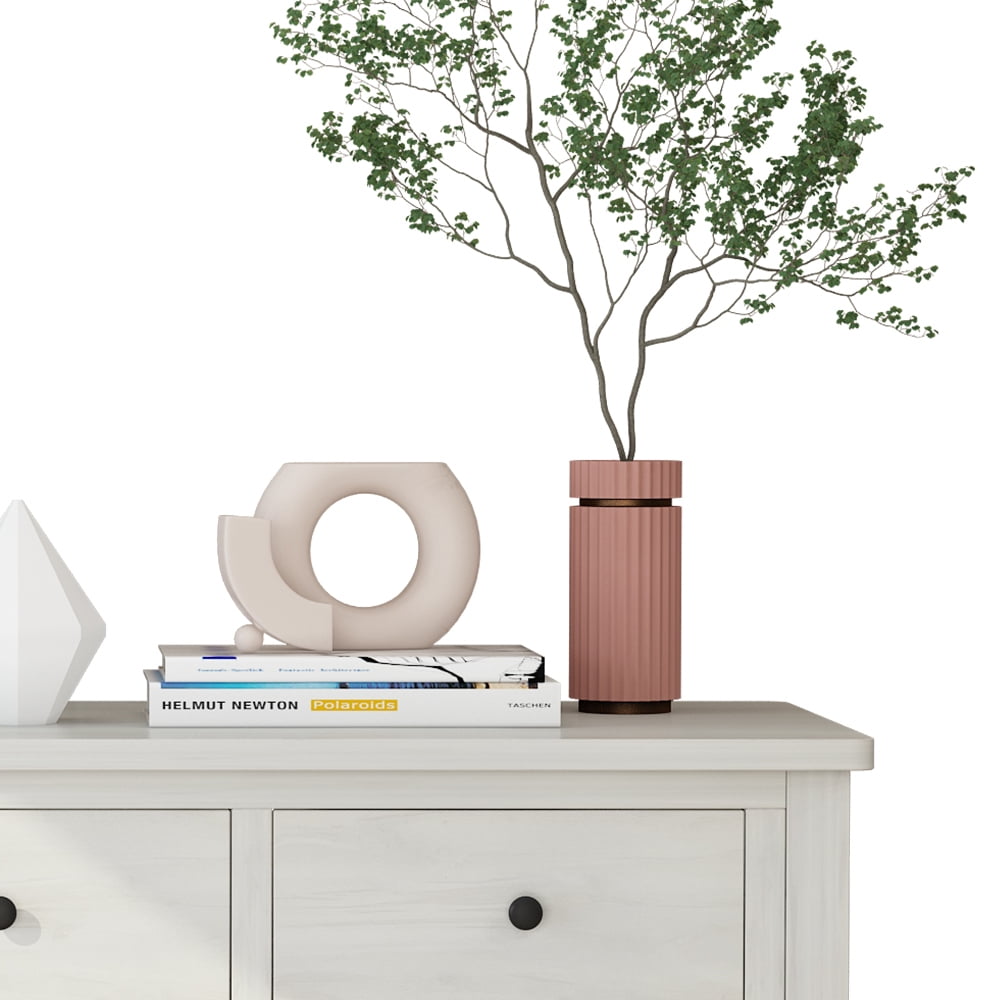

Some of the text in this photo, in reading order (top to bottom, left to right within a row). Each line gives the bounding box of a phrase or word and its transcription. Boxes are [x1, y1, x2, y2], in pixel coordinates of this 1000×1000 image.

[162, 699, 396, 711] HELMUT NEWTON Polaroids
